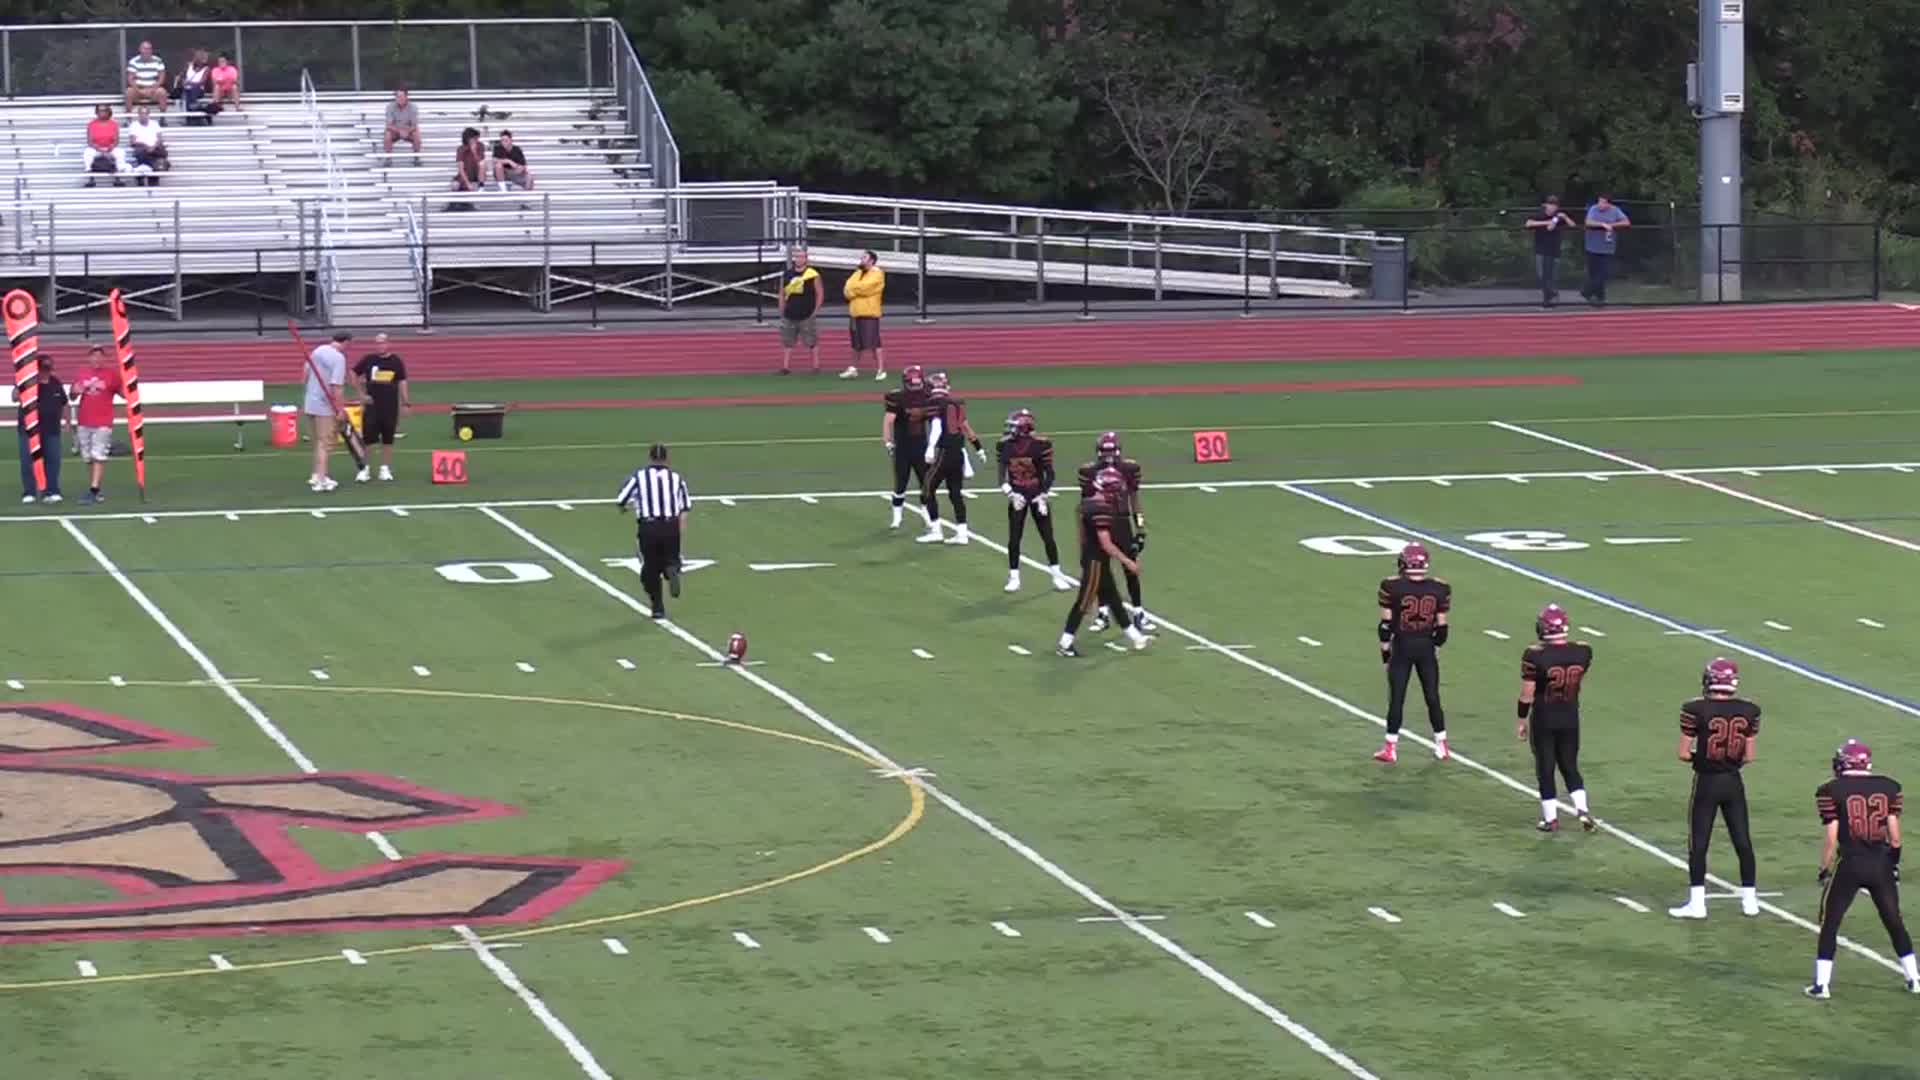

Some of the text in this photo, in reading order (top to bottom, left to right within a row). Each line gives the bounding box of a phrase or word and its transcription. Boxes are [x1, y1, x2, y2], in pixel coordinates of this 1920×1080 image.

[1198, 435, 1226, 458] 30
[436, 456, 465, 480] 40
[1707, 716, 1749, 761] 26
[1846, 792, 1890, 842] 82
